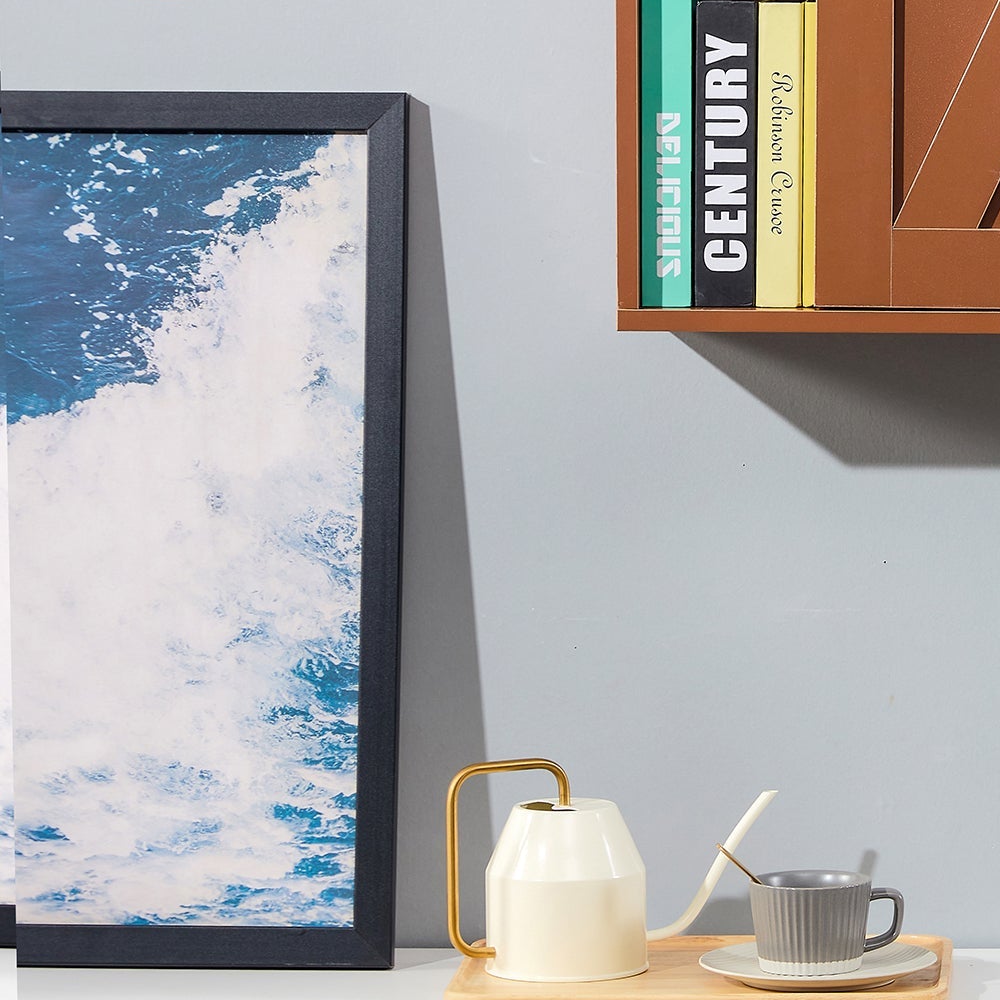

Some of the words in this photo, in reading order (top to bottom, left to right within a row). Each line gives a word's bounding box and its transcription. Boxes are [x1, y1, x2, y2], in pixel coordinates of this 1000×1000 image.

[703, 33, 749, 272] CENTURY
[770, 71, 794, 162] Robinson
[656, 112, 681, 278] DELICIOUS
[770, 170, 794, 235] Crusoe
